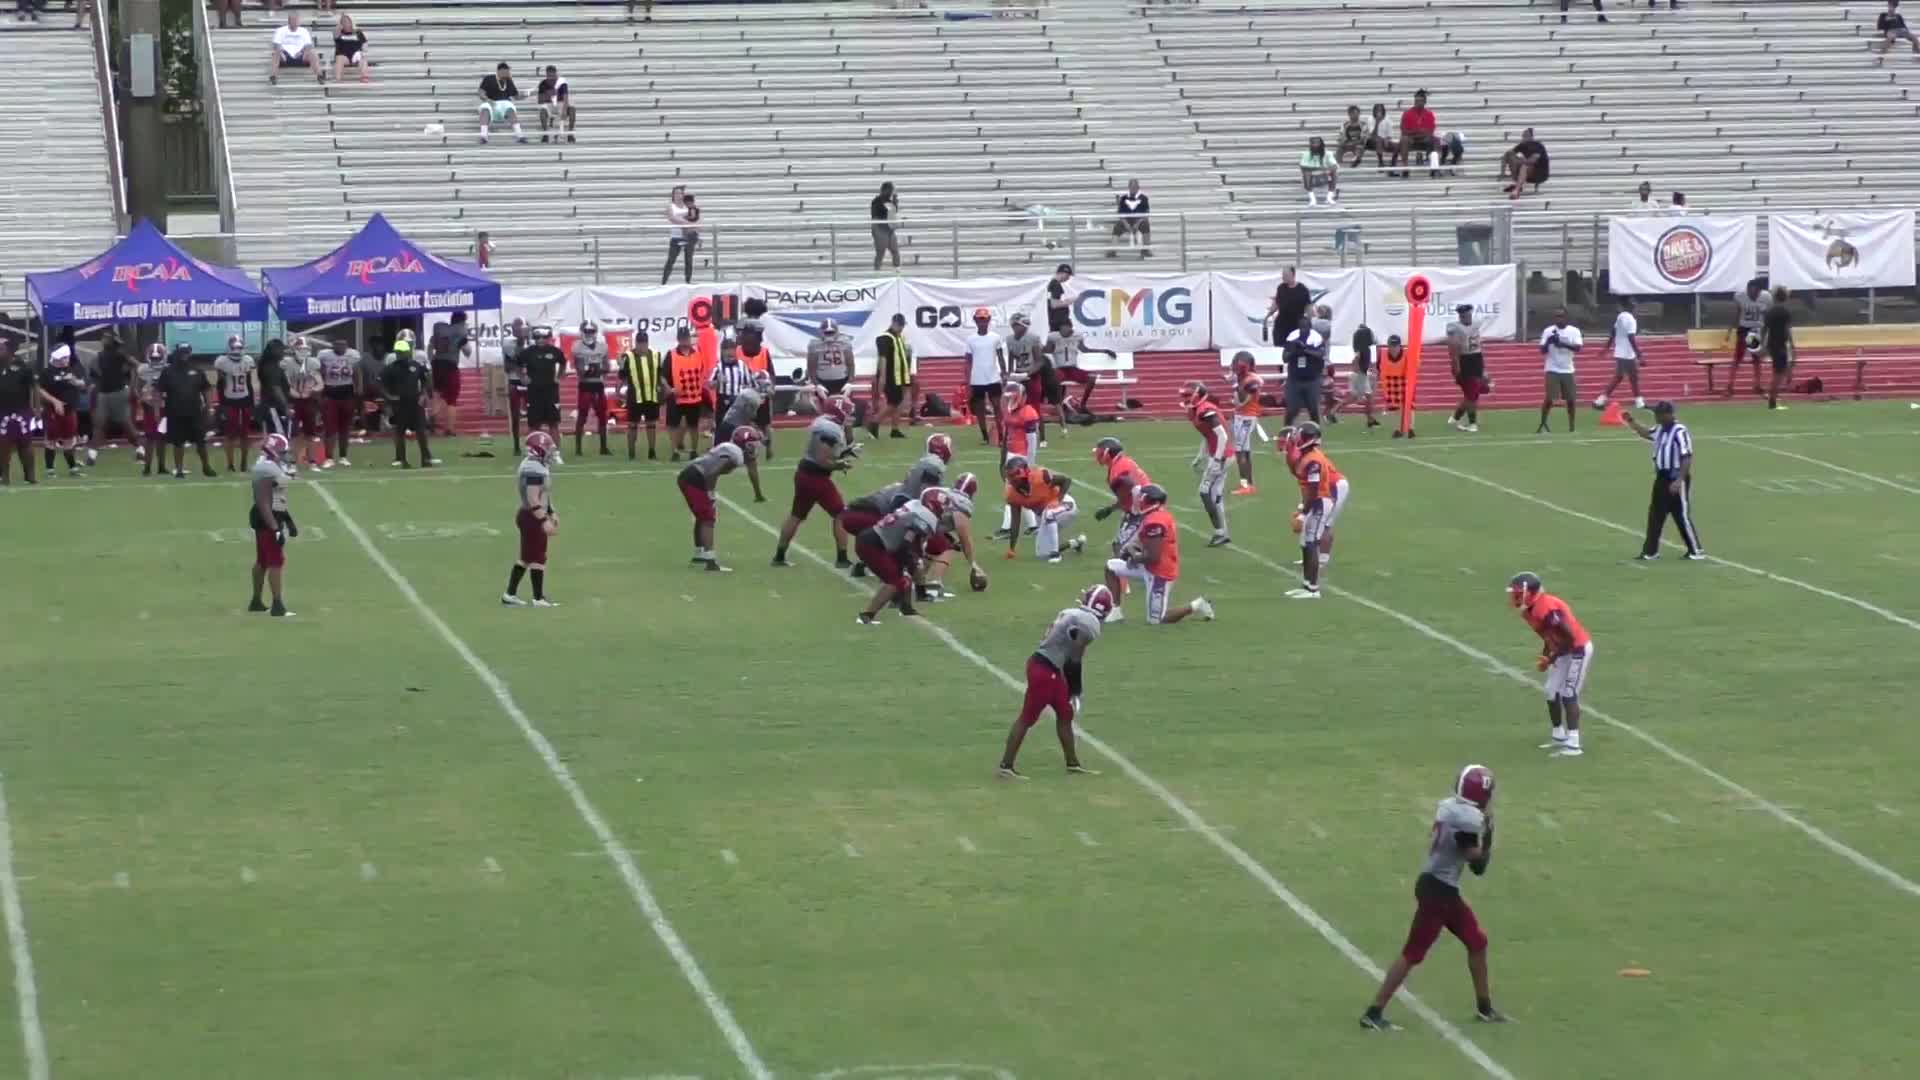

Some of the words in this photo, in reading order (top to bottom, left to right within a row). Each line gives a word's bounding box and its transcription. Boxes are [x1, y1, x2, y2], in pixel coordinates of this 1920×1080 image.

[307, 296, 347, 314] Broward
[350, 295, 382, 312] County
[385, 291, 420, 310] Athletic
[424, 289, 473, 308] Association
[764, 288, 876, 304] PARAGON
[73, 302, 113, 319] Broward
[116, 301, 148, 319] County
[151, 299, 187, 317] Athletic
[190, 299, 240, 317] Association
[1073, 287, 1193, 328] CMG
